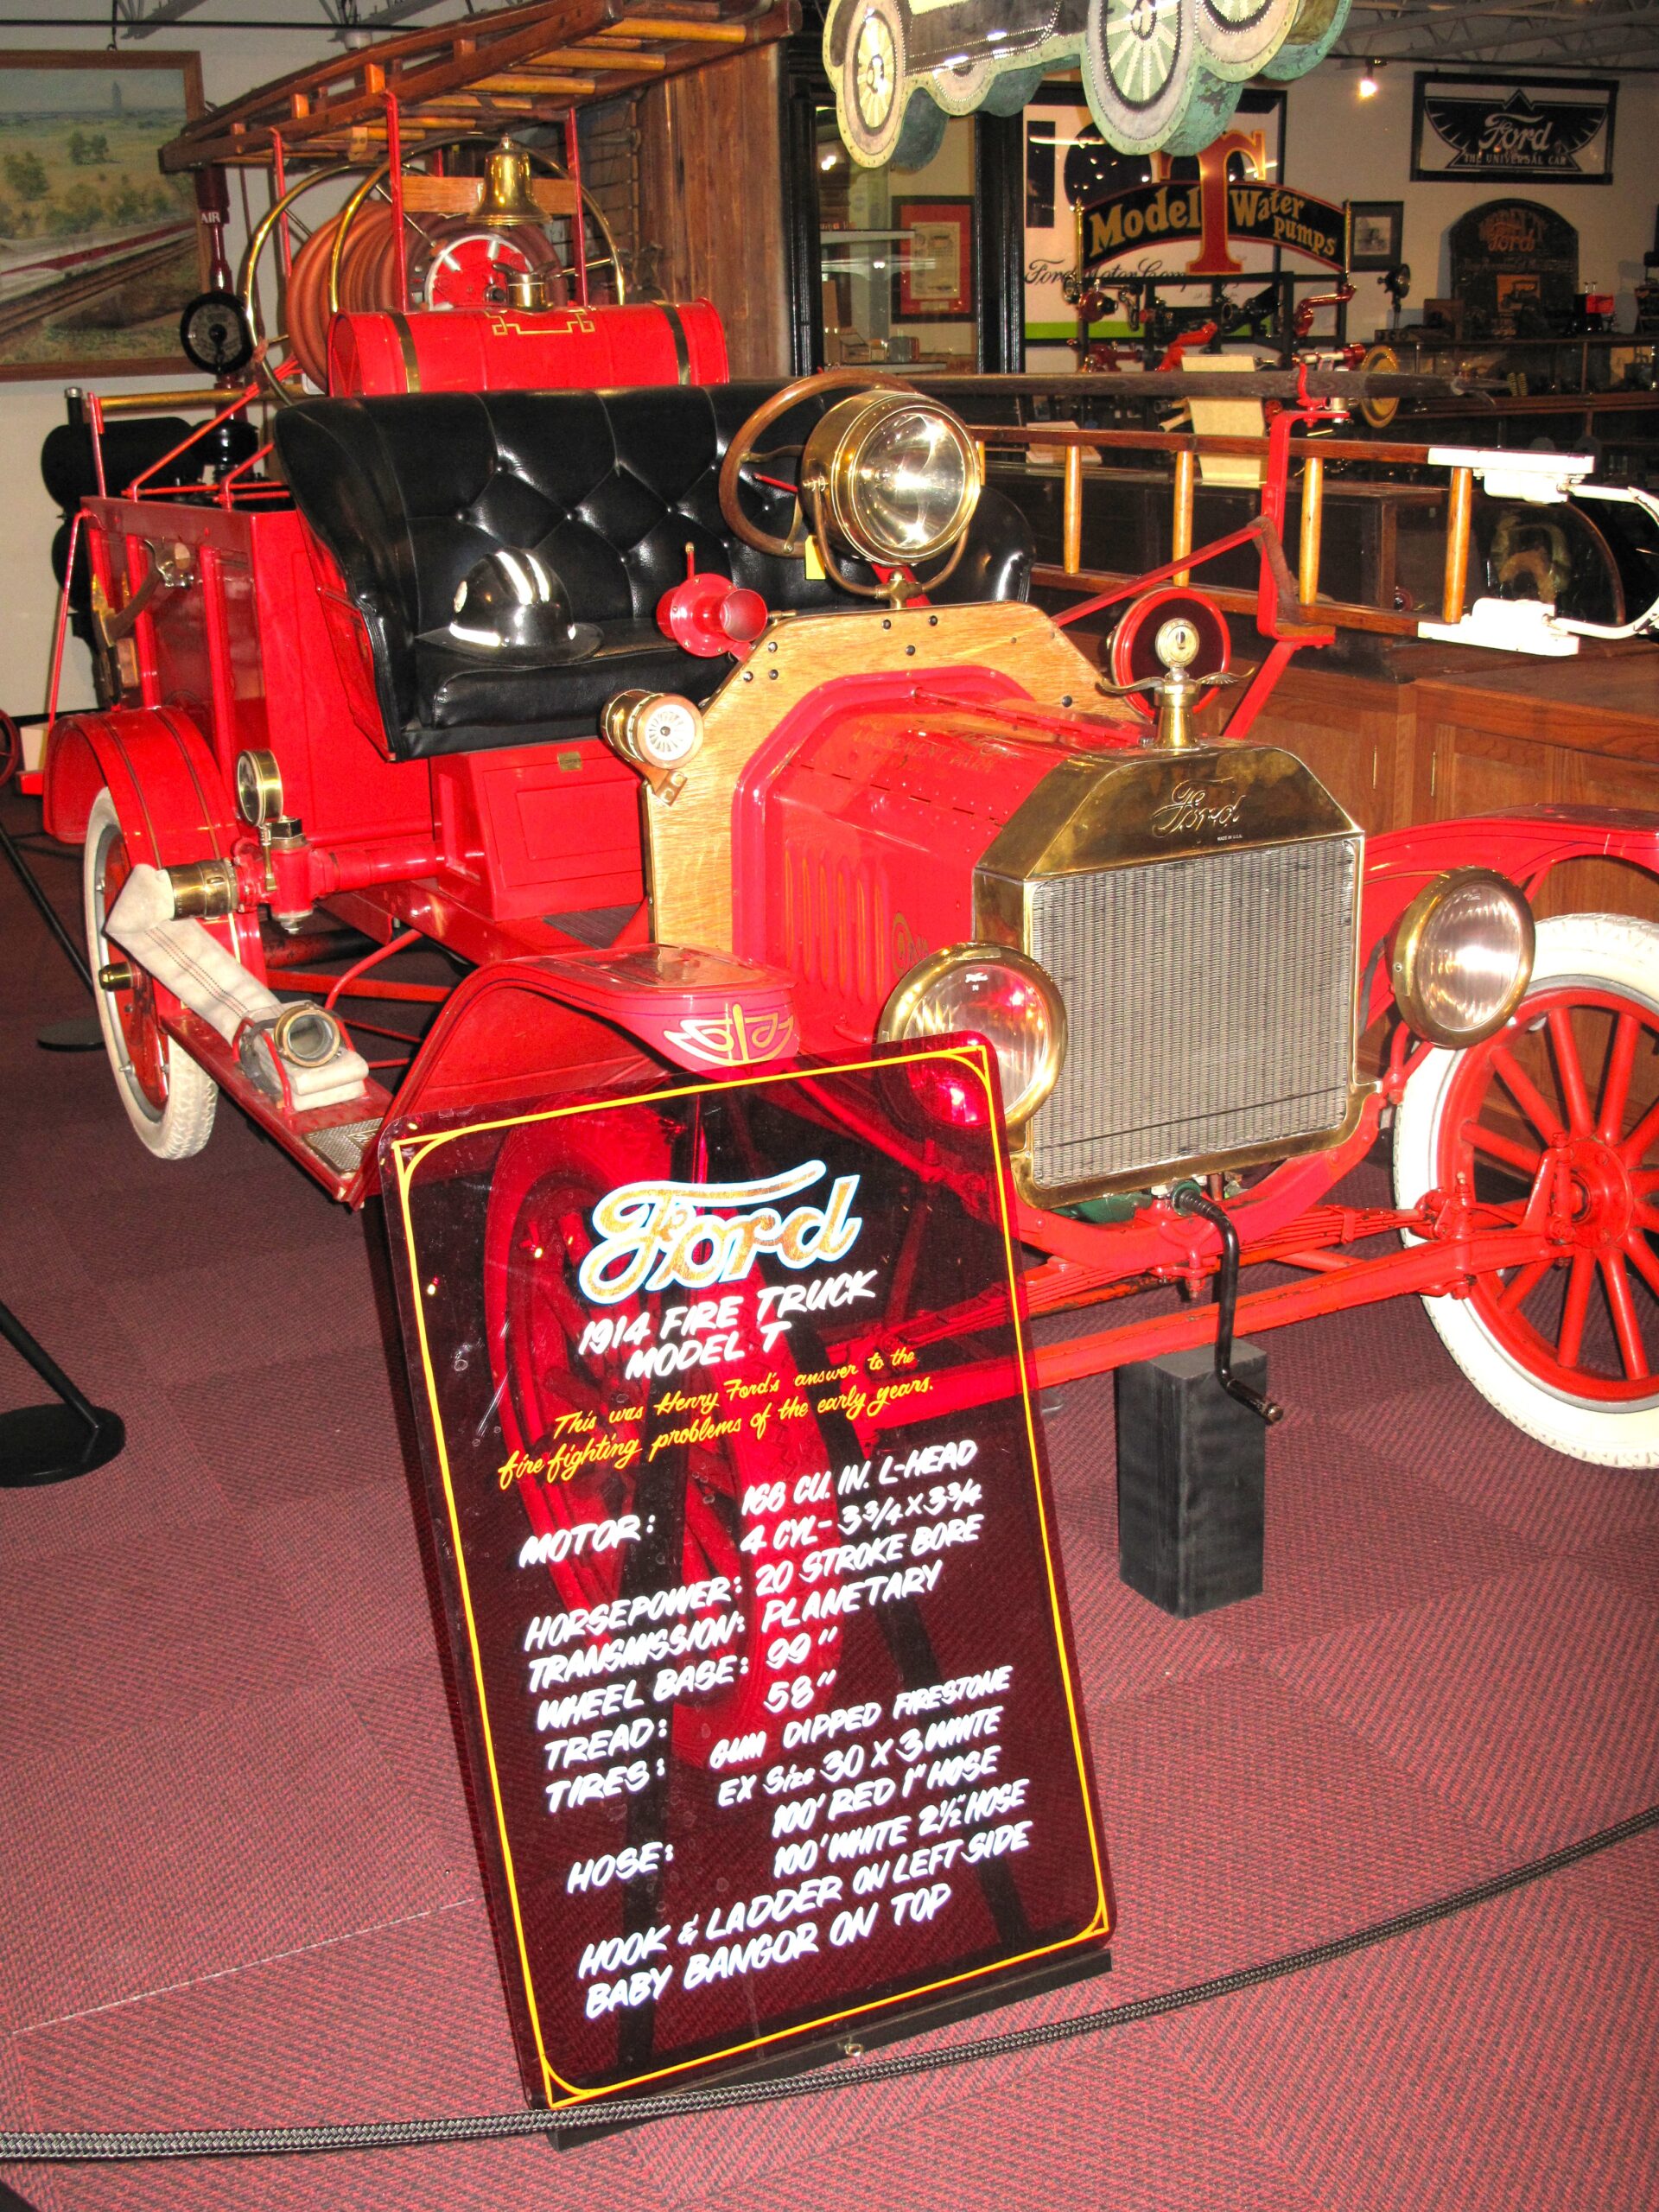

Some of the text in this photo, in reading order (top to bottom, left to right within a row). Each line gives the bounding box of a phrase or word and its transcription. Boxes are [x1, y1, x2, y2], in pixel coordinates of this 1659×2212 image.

[1478, 112, 1553, 150] Ford
[200, 212, 221, 224] AIR
[1089, 185, 1201, 257] Model
[1230, 188, 1305, 227] Water
[1273, 215, 1337, 257] pumps
[1487, 221, 1535, 252] Ford
[1151, 776, 1247, 838] Ford
[579, 1159, 862, 1305] Ford
[578, 1269, 878, 1356] 1914 FIRE TRUCK
[625, 1320, 792, 1381] MODEL T
[553, 1346, 915, 1440] This was Henry Ford's answer to the
[497, 1376, 933, 1491] fire fighting problems of the early years.
[792, 1471, 832, 1504] CU.
[837, 1460, 872, 1496] IN.
[878, 1439, 978, 1485] L-HEAD
[739, 1524, 767, 1555] 4
[755, 1560, 794, 1597] 20
[798, 1533, 907, 1583] STROKE
[910, 1513, 985, 1557] BORE
[761, 1559, 944, 1633] PLANETARY
[537, 1679, 645, 1732] WHEEL
[709, 1730, 767, 1770] GUM
[782, 1701, 882, 1749] DIPPED
[892, 1665, 1014, 1719] FIRESTONE
[717, 1774, 758, 1807] EX
[762, 1764, 816, 1795] Size
[819, 1744, 865, 1783] 30
[895, 1727, 925, 1763] 3
[924, 1705, 1004, 1752] WHITE
[827, 1777, 897, 1821] RED
[926, 1745, 1001, 1789] HOSE
[828, 1815, 912, 1863] WHITE
[963, 1778, 1030, 1824] HOSE
[578, 1820, 1033, 1980] HOOK & LADDER ON LEFT SIDE
[586, 1883, 951, 2019] BABY BANGOR ON TOP
